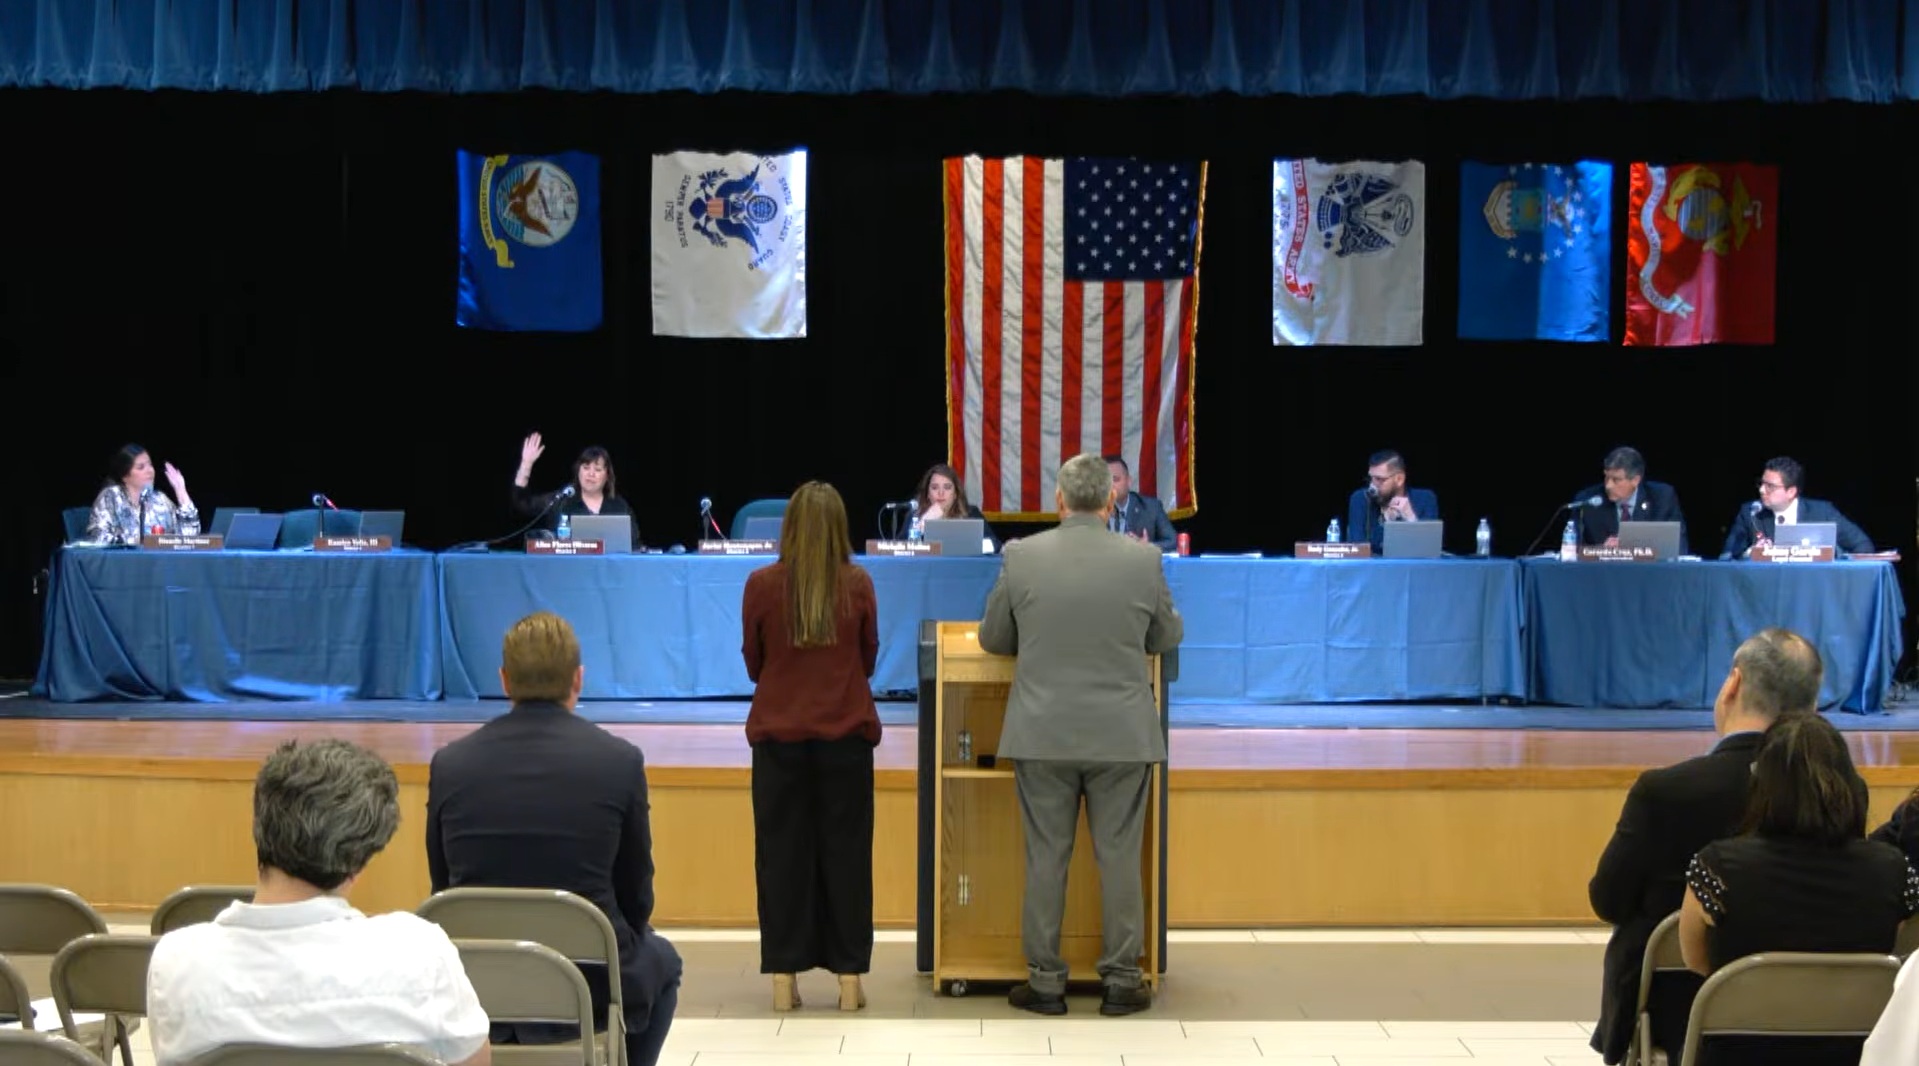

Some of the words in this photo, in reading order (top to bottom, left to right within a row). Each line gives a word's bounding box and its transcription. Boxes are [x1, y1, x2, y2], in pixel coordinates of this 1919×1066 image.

[677, 174, 692, 208] SEMPER
[778, 176, 794, 206] STATES
[676, 210, 689, 248] PARATUS
[778, 215, 794, 242] COAST
[1293, 195, 1307, 243] STATES
[748, 248, 774, 271] GUARD
[1285, 248, 1300, 284] ARMY
[370, 538, 378, 546] III
